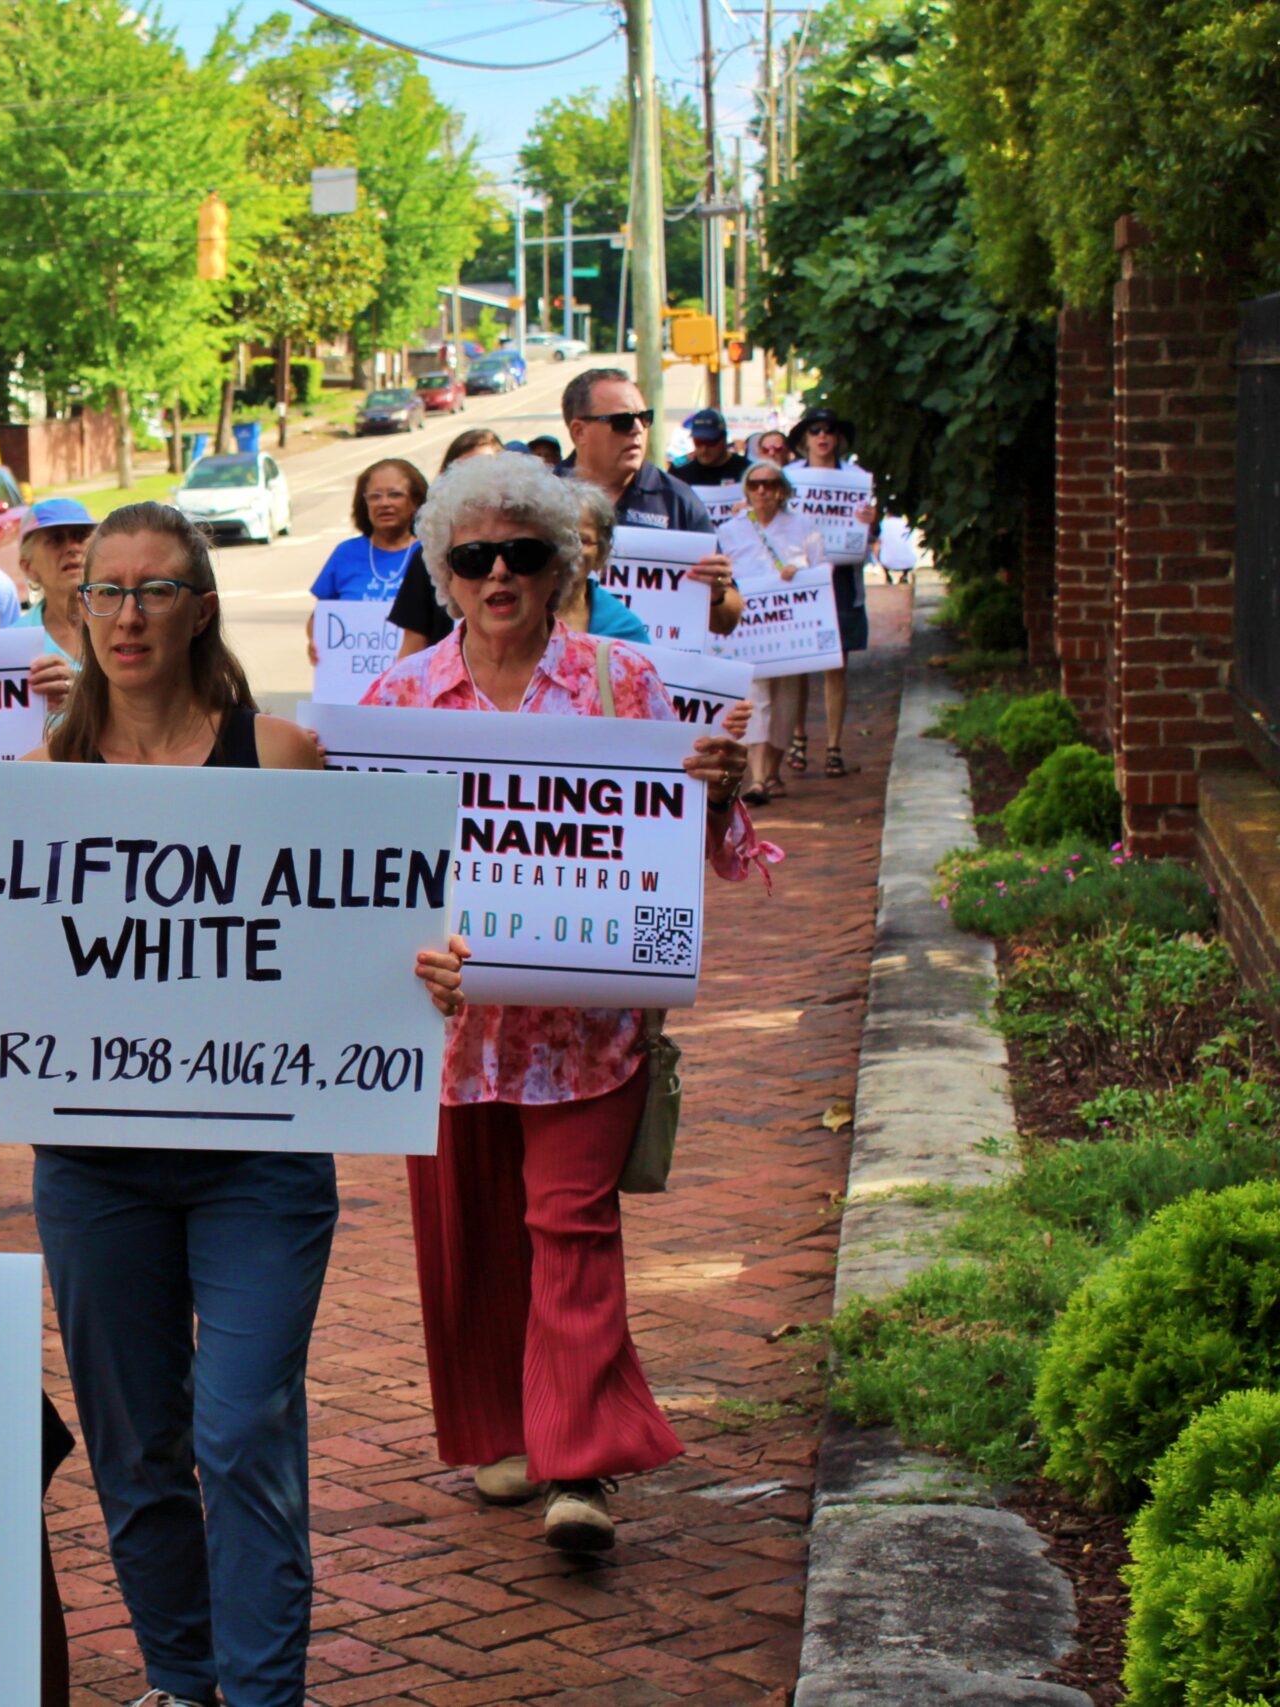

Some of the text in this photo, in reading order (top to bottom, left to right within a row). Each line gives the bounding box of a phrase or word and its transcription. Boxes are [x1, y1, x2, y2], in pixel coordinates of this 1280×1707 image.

[803, 503, 853, 518] NAME!
[806, 489, 866, 503] JUSTICE
[636, 566, 686, 591] MY
[773, 594, 789, 606] IN
[793, 589, 818, 603] MY
[327, 612, 398, 650] Donald
[740, 608, 794, 626] NAME!
[351, 654, 395, 674] EXEC
[672, 695, 724, 725] MY
[454, 771, 685, 819] ILLING IN
[460, 817, 625, 861] NAME!
[261, 847, 451, 910] ALLEN
[61, 915, 282, 983] WHITE
[335, 1043, 424, 1093] 2001
